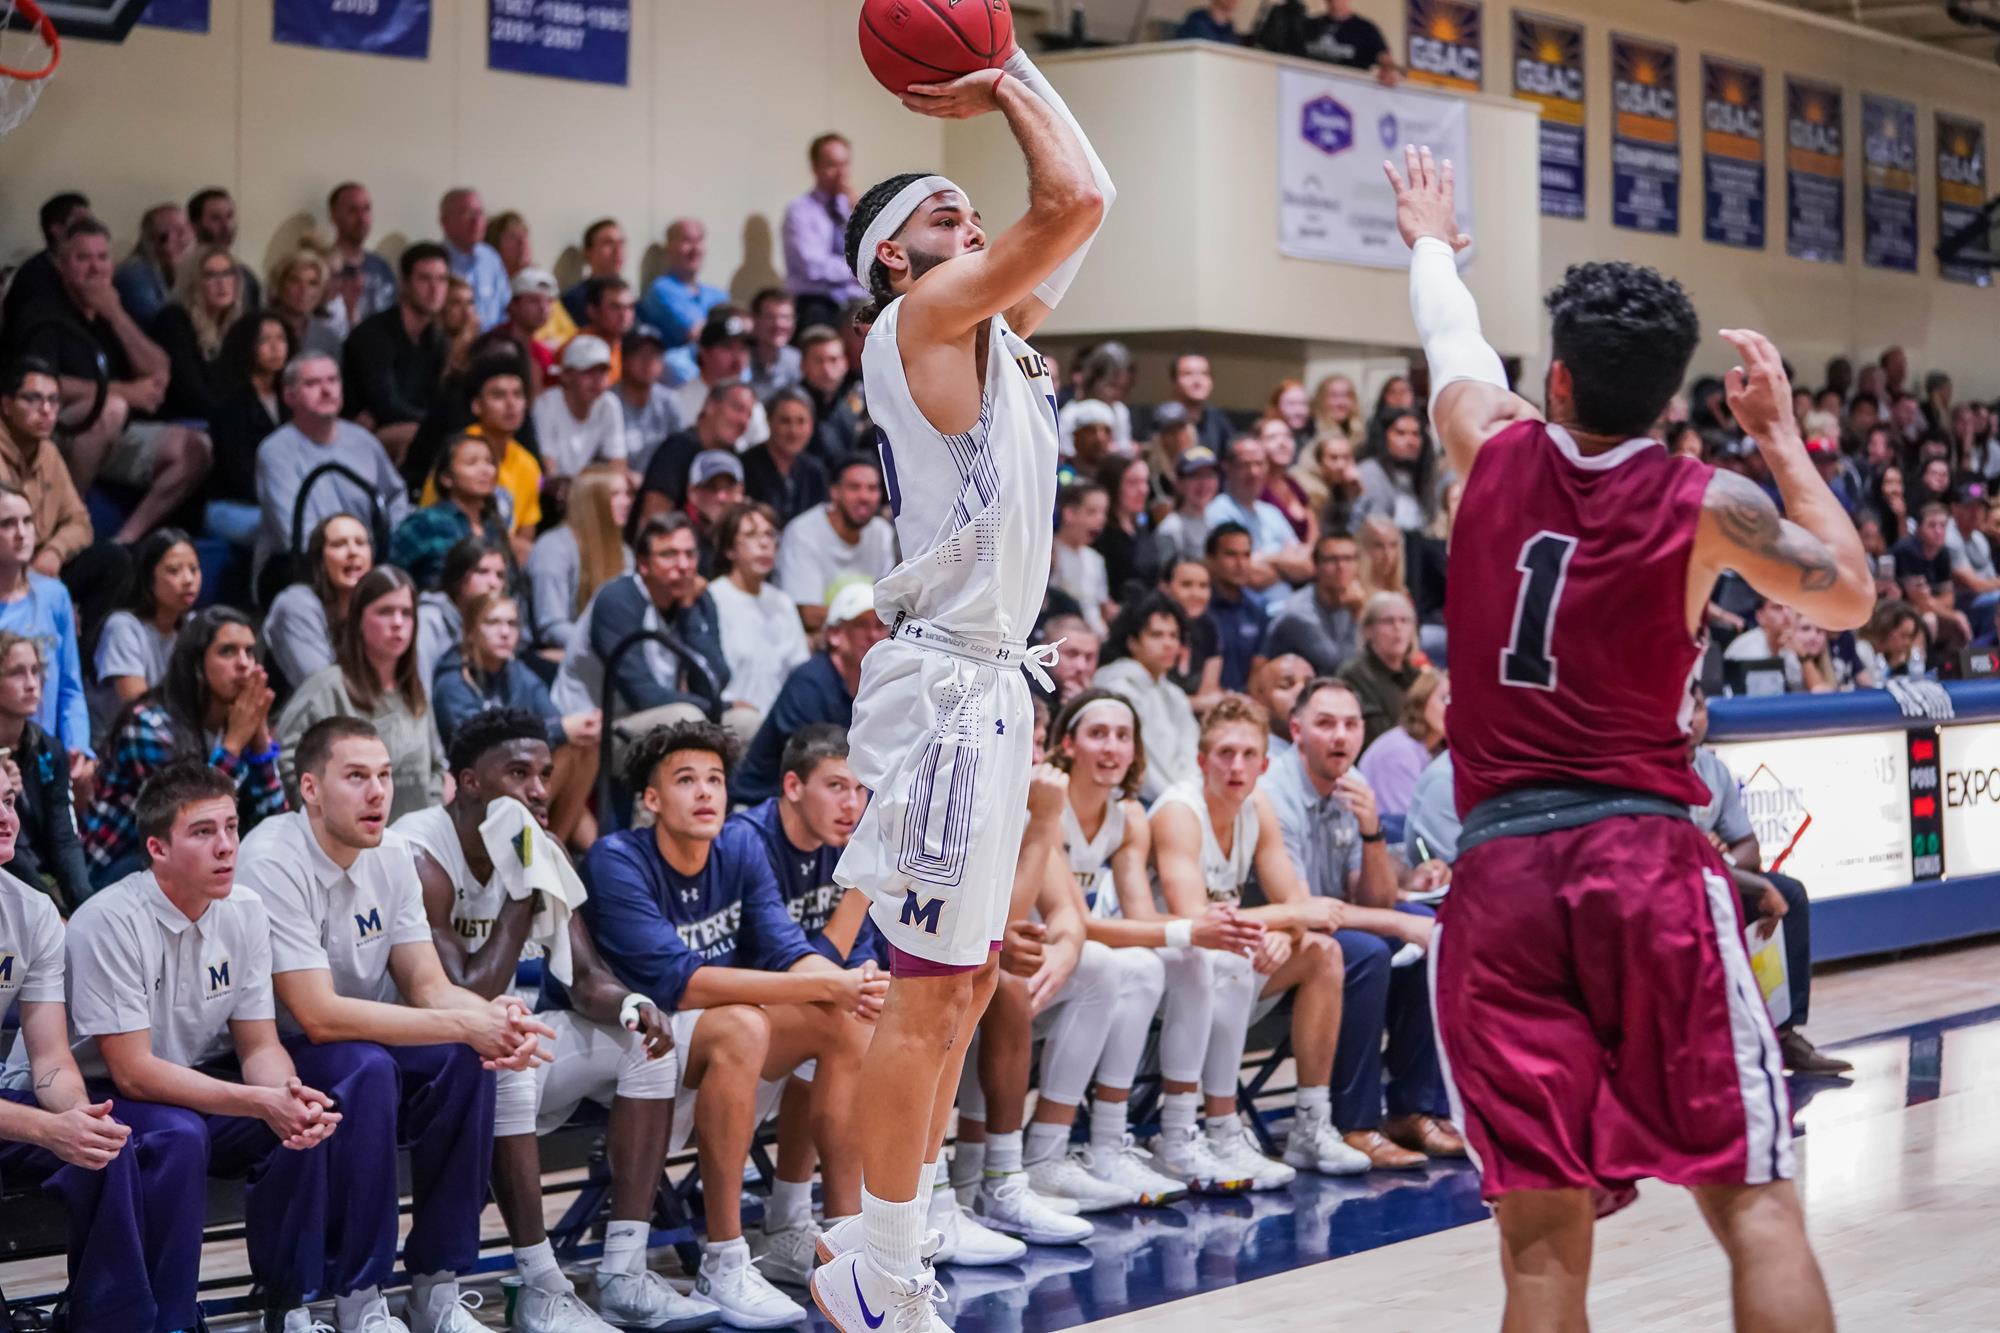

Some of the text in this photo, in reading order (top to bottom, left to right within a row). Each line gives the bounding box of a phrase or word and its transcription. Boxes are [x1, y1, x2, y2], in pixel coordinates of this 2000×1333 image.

[1409, 35, 1482, 81] GSAC
[1516, 58, 1582, 99] GSAC
[1614, 80, 1676, 119] GSAC
[1704, 100, 1763, 138] GSAC
[1789, 118, 1841, 155] GSAC
[1938, 152, 1982, 186] GSAC
[1499, 529, 1579, 693] 1
[1910, 766, 1938, 789] POSS
[354, 907, 383, 937] M
[899, 888, 946, 934] M
[208, 961, 230, 990] M
